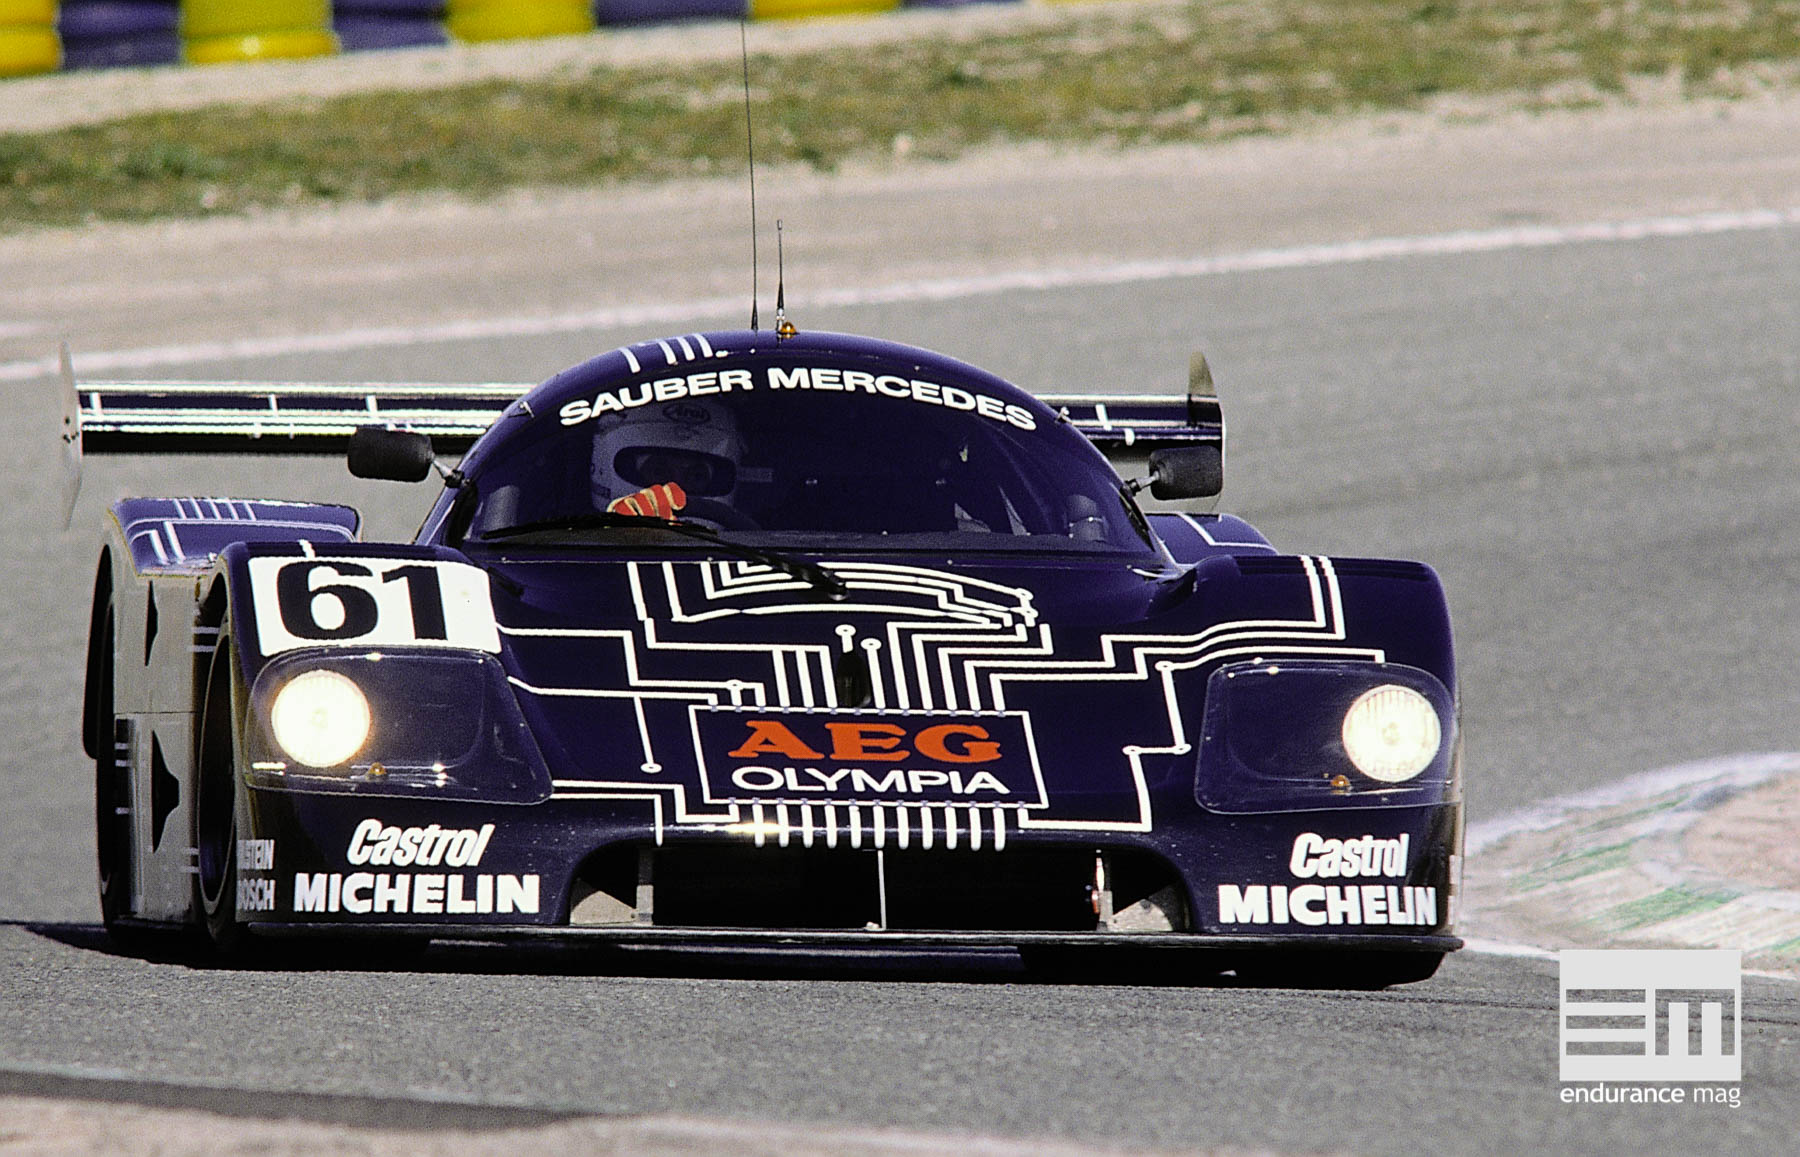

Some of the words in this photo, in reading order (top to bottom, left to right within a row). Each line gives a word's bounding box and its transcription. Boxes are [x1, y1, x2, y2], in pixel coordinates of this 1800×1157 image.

[559, 368, 754, 426] SAUBER
[767, 367, 1037, 430] MERCEDES
[276, 560, 449, 642] 61
[728, 720, 1003, 763] AEG
[731, 766, 1011, 795] OLYMPIA
[346, 818, 496, 868] Castrol
[1289, 832, 1410, 879] Castrol
[293, 872, 541, 915] MICHELIN
[1218, 884, 1438, 926] MICHELIN
